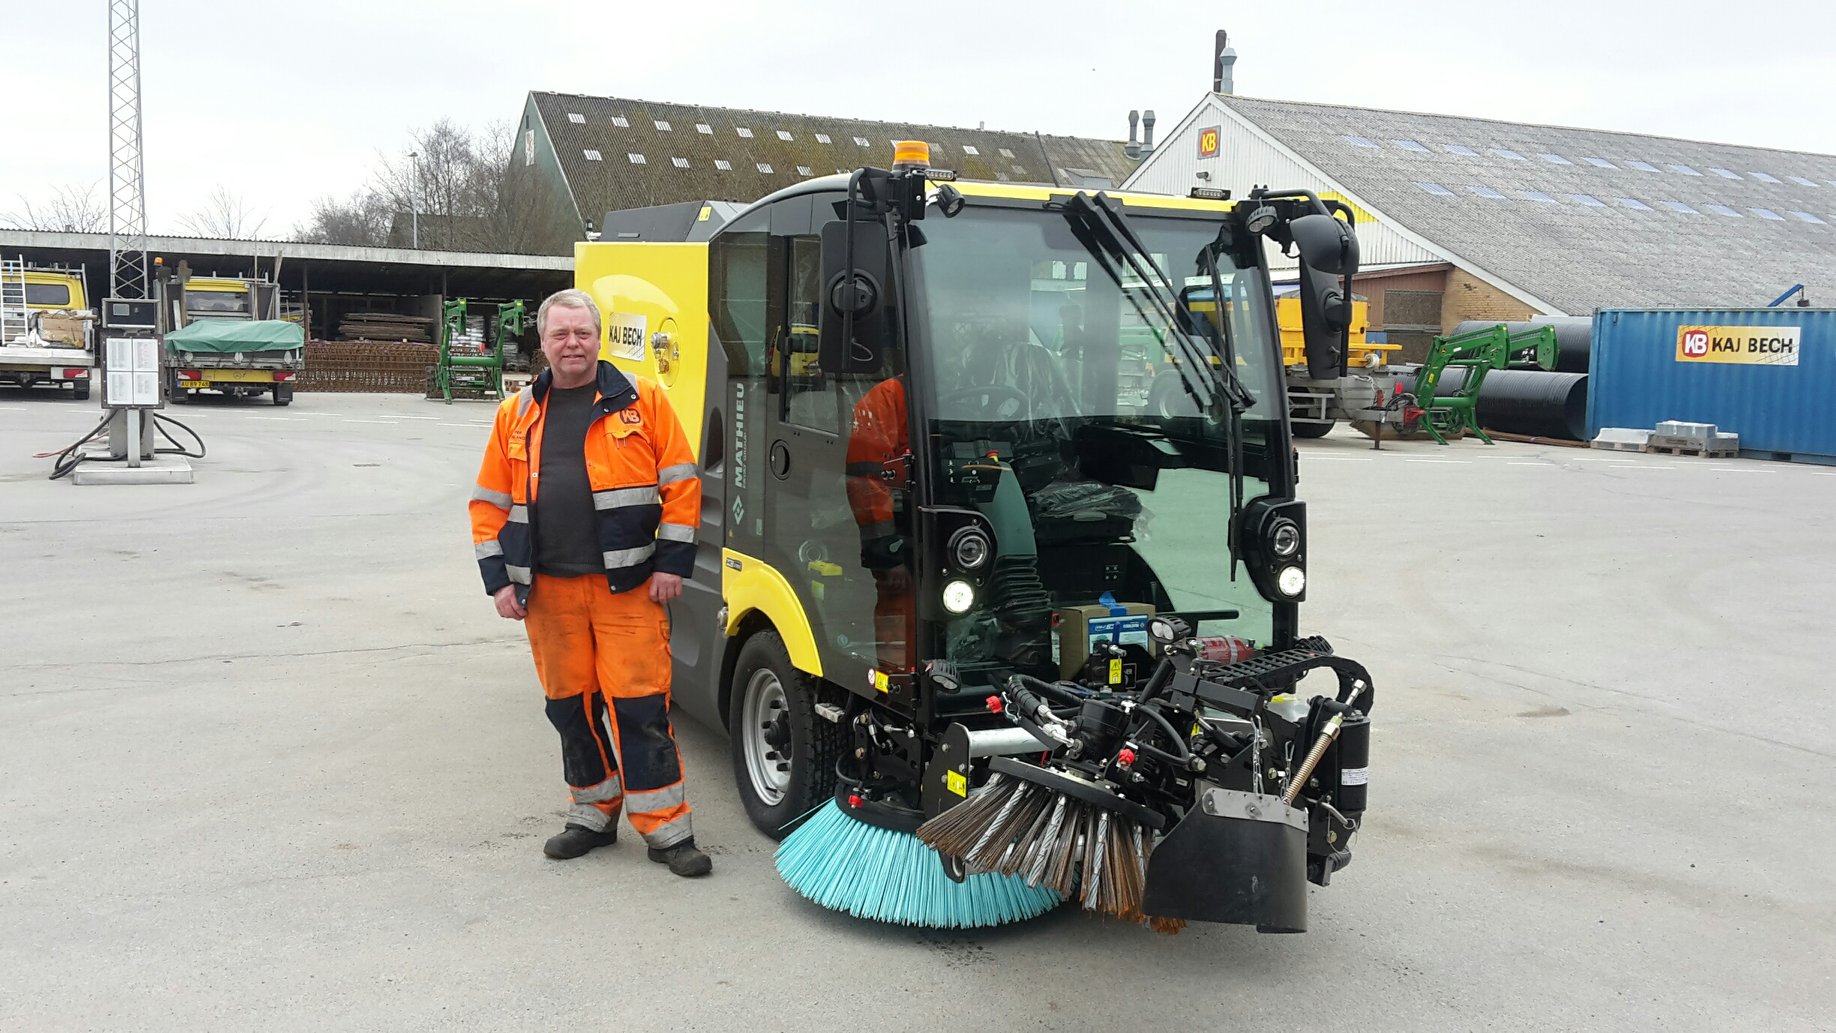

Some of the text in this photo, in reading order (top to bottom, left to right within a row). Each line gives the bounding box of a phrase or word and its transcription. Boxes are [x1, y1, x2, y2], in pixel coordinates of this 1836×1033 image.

[1202, 132, 1217, 153] KB
[609, 325, 643, 346] KAJ BECH
[1684, 333, 1793, 354] KB KAJ BECH
[621, 409, 640, 423] KB
[734, 382, 745, 488] MATHIEU
